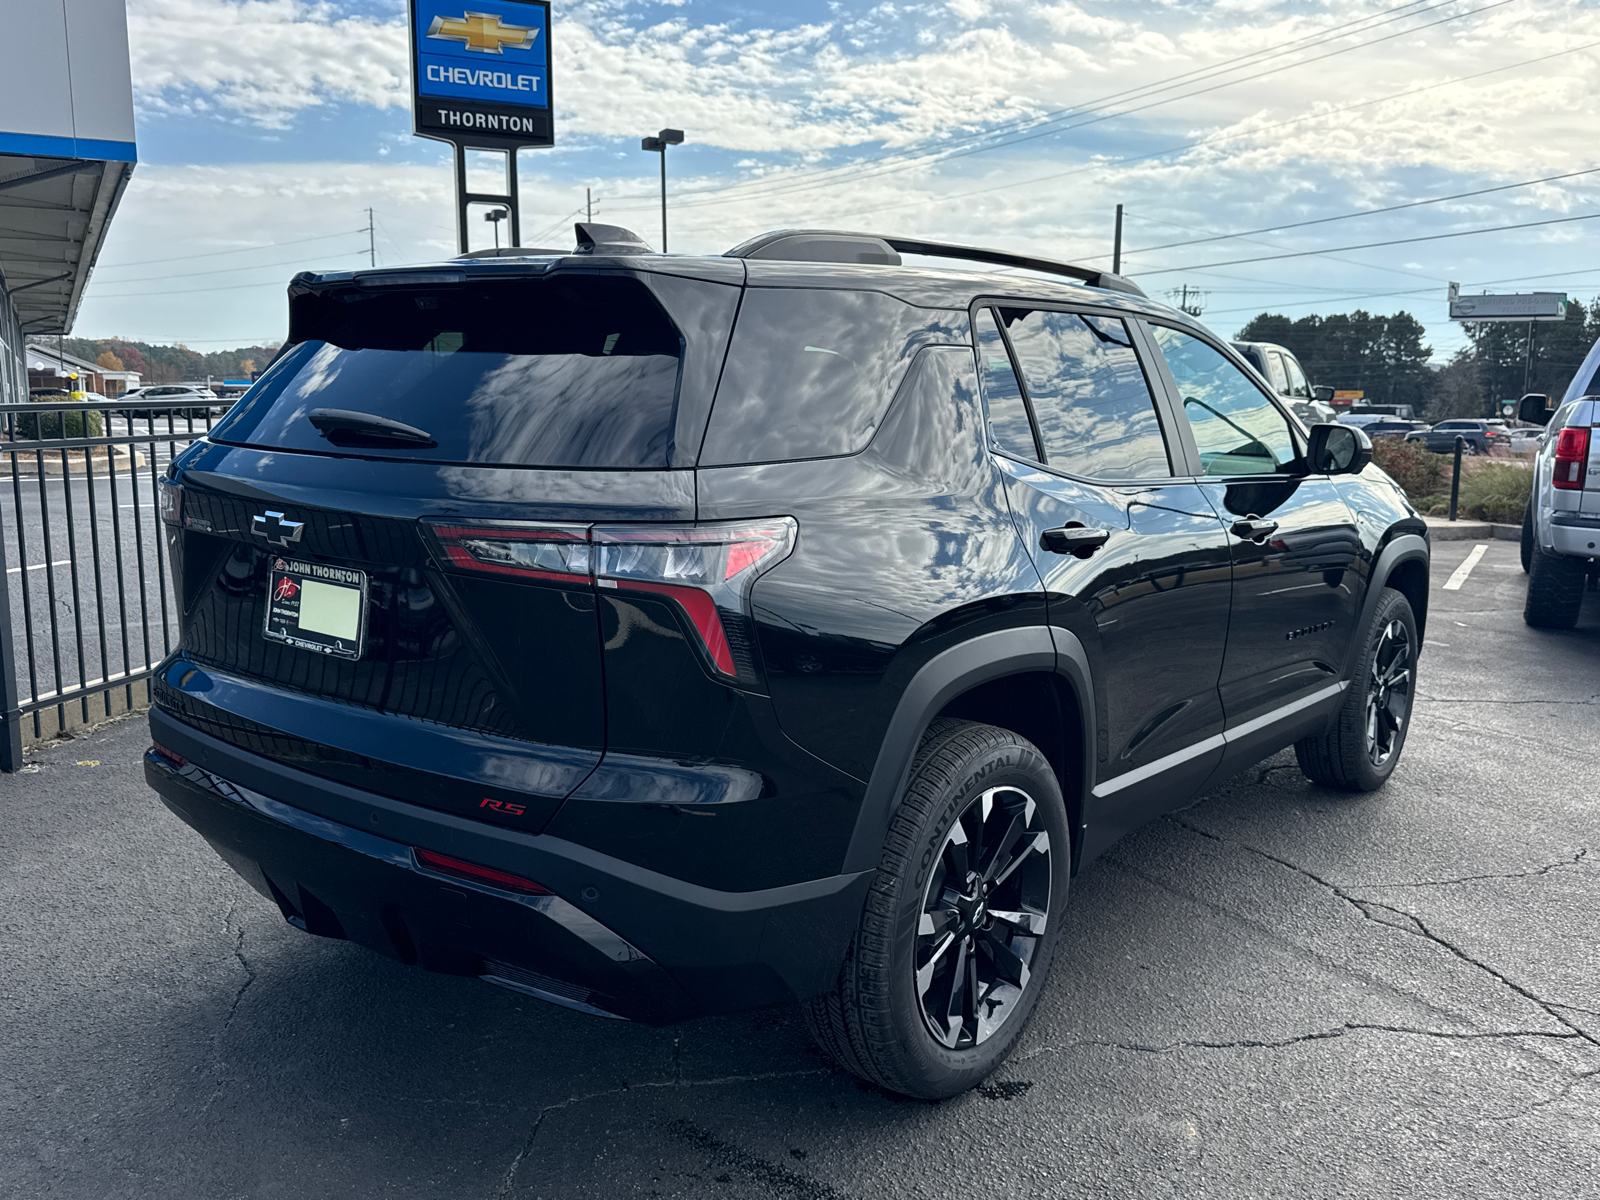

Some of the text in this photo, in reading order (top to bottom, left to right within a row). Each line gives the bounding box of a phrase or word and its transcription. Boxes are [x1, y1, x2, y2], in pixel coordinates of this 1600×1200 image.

[427, 65, 540, 91] CHEVROLET
[438, 110, 533, 132] THORNTON
[289, 561, 359, 583] JOHN THORNTON
[280, 609, 298, 617] THORNTON
[295, 641, 322, 651] CHEVROLET
[479, 798, 528, 816] RS
[914, 755, 1015, 891] CONTINENTAL
